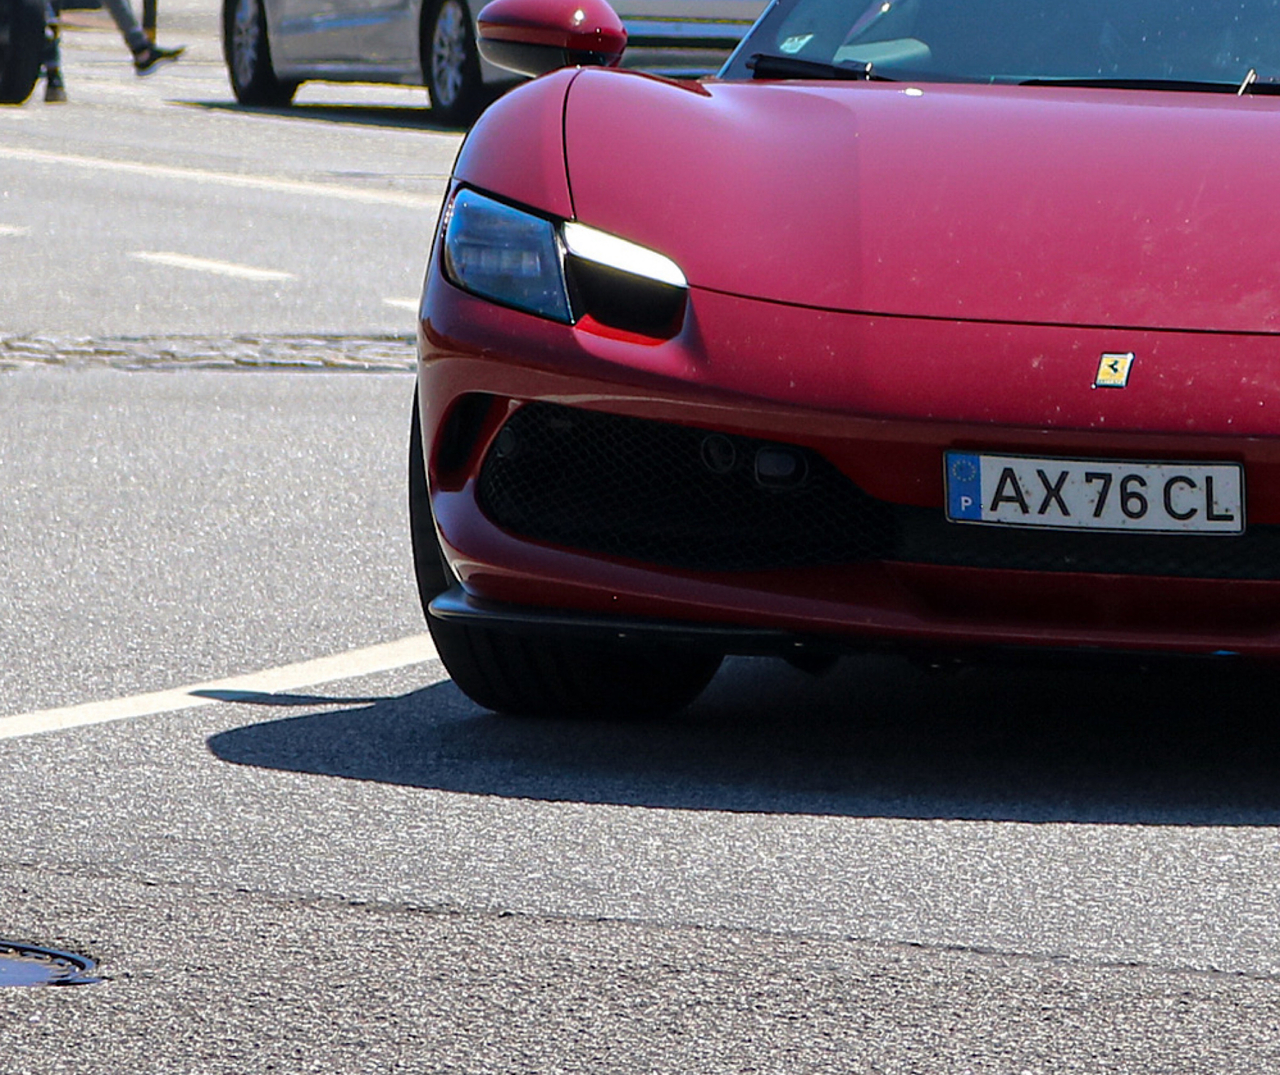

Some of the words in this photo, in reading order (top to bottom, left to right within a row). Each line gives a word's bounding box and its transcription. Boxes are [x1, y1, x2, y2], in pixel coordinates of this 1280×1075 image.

[960, 496, 973, 511] P
[989, 467, 1071, 517] AX
[1084, 472, 1149, 520] 76
[1163, 475, 1235, 522] CL
